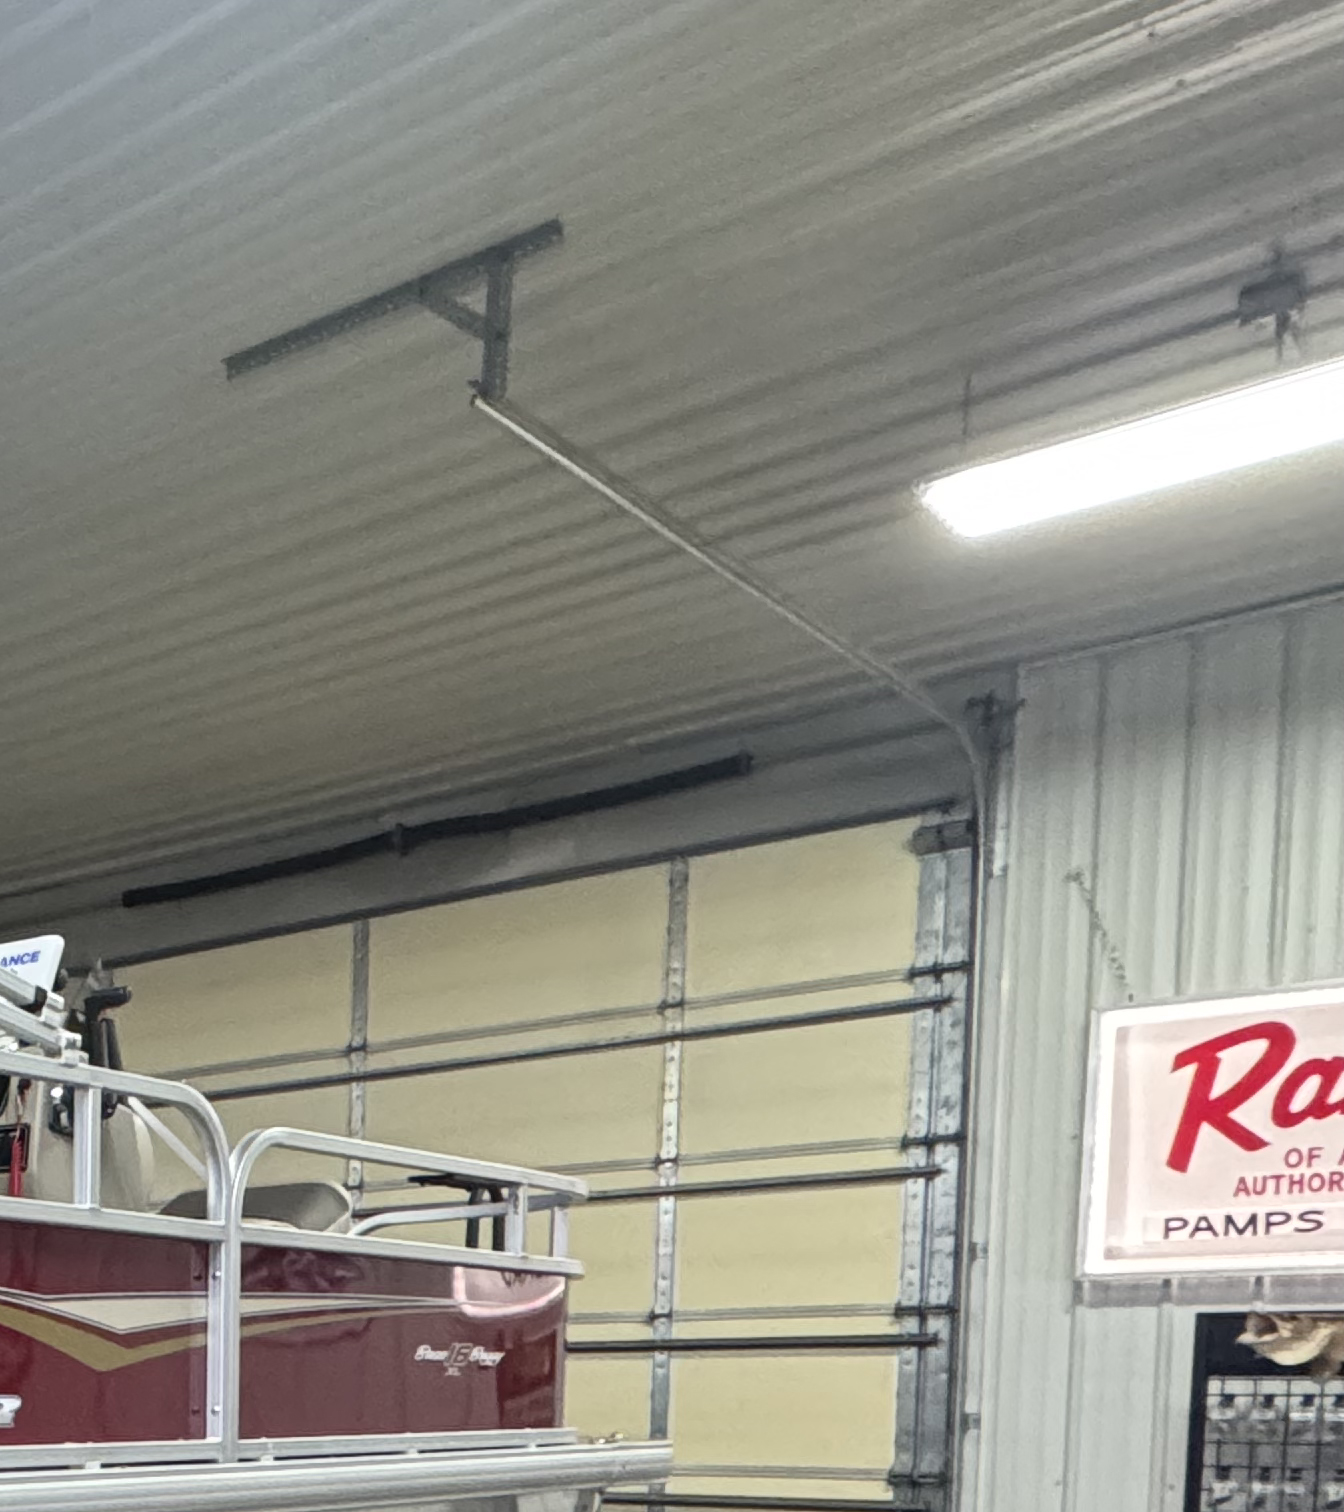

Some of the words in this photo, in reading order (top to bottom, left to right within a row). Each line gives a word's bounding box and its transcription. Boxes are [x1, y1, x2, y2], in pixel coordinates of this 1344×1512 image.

[1166, 1020, 1344, 1174] Ra
[1284, 1147, 1324, 1169] OF
[1233, 1172, 1344, 1198] AUTHOR
[1163, 1210, 1324, 1240] PAMPS
